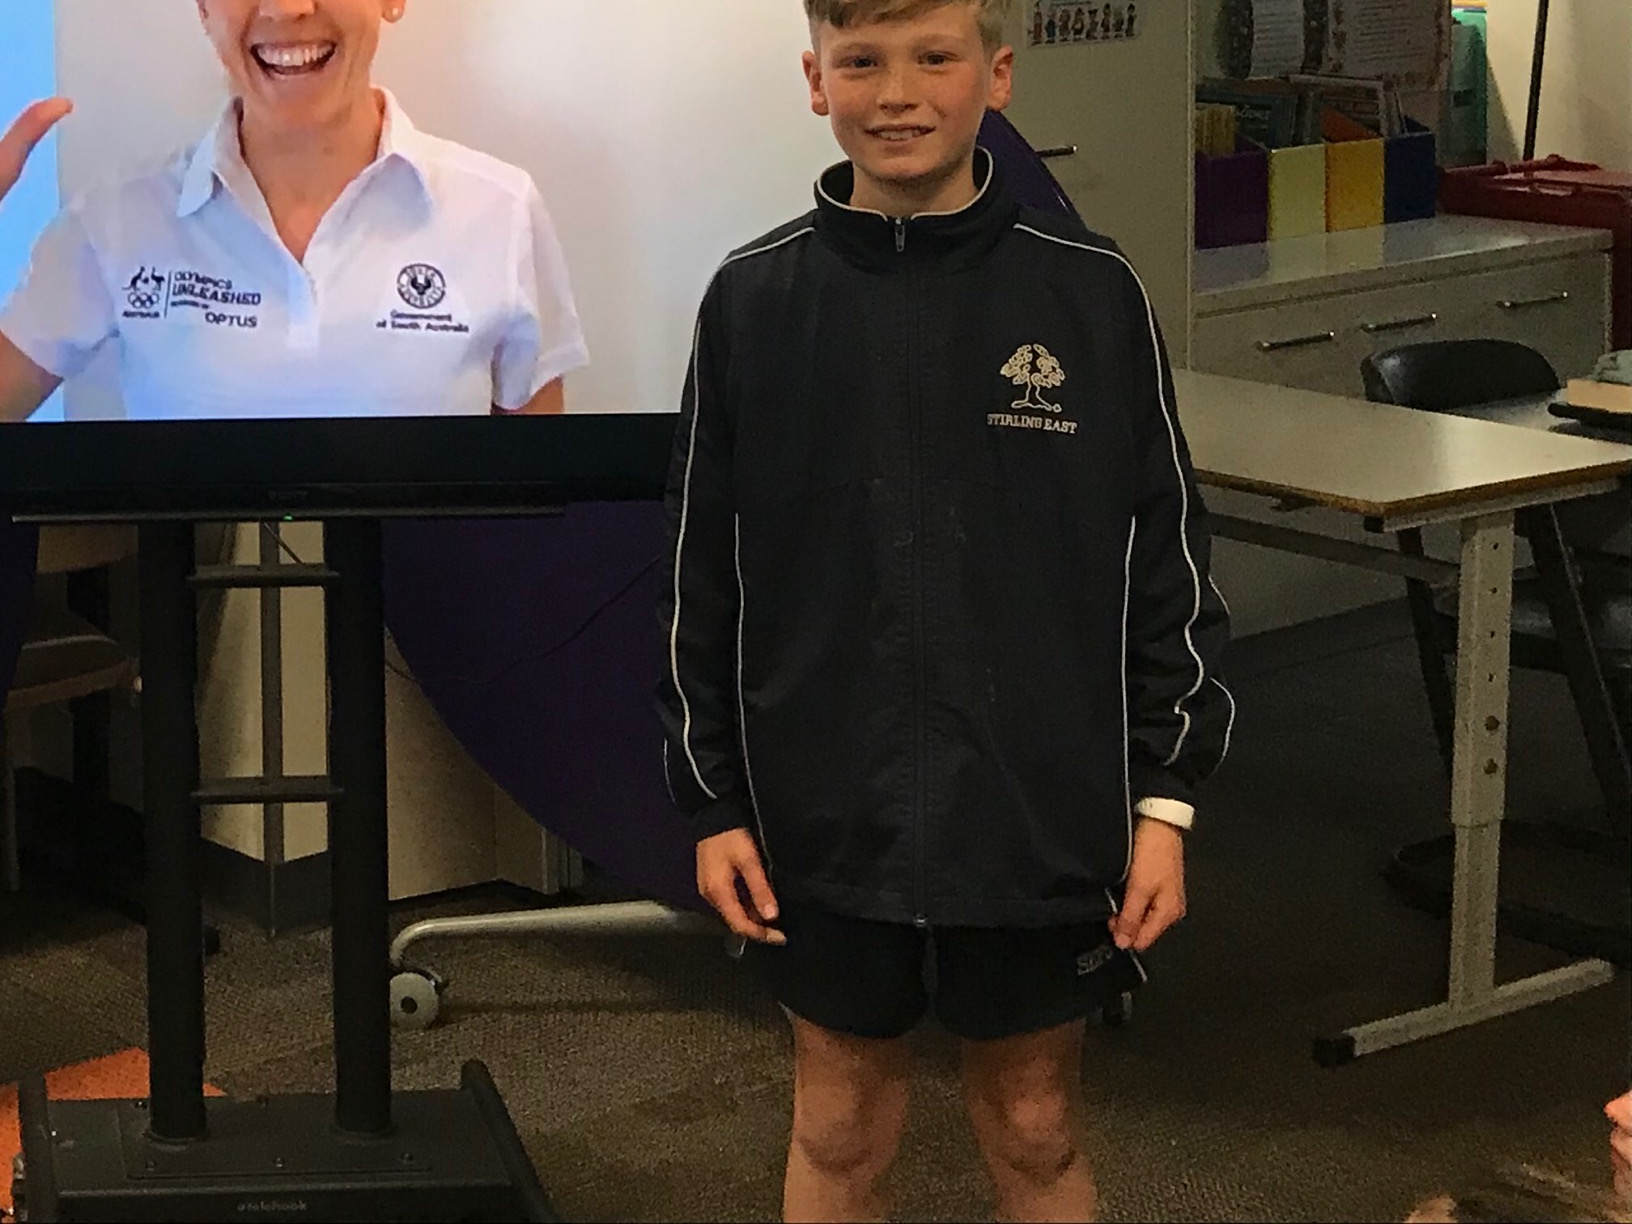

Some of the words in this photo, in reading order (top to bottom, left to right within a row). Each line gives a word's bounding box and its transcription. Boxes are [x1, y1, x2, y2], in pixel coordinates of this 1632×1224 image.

[171, 283, 262, 306] UNLEASHED
[205, 312, 257, 328] OPTUS
[987, 413, 1043, 429] STIRLING
[1043, 418, 1078, 434] EAST
